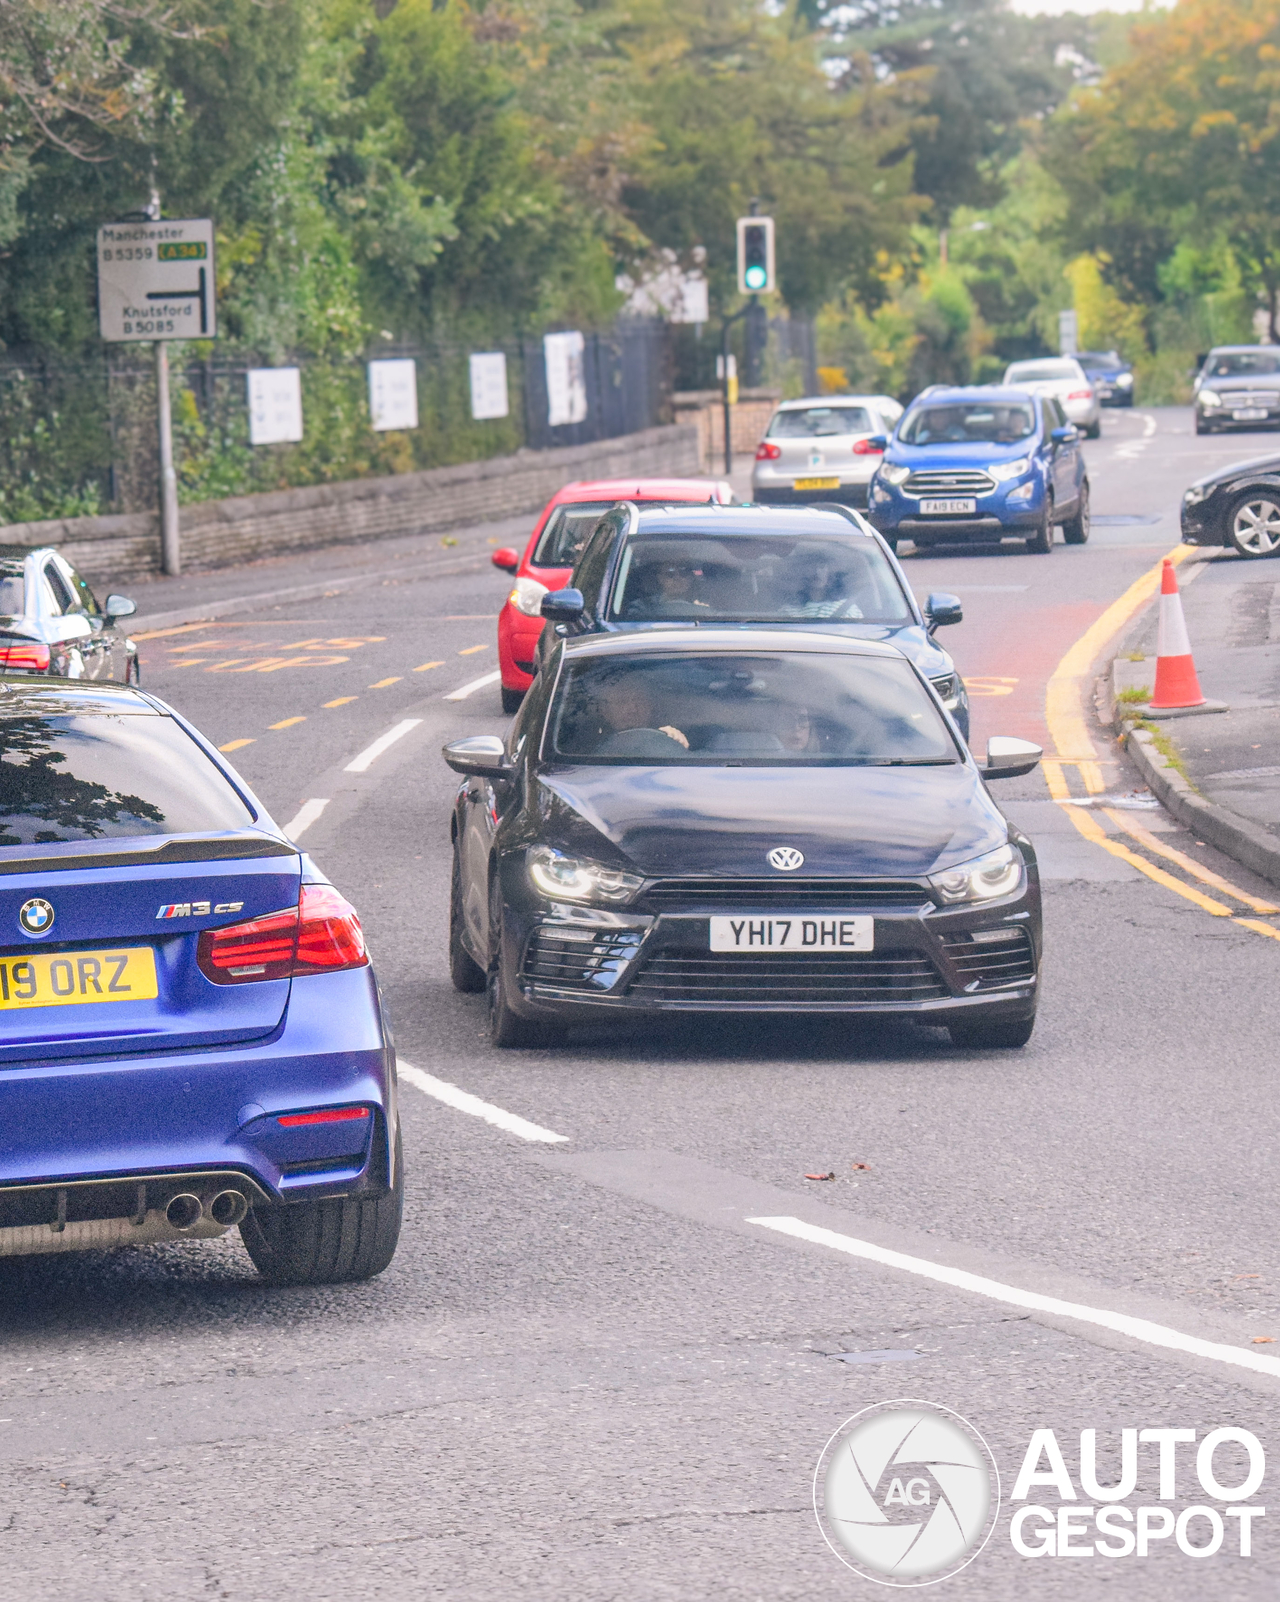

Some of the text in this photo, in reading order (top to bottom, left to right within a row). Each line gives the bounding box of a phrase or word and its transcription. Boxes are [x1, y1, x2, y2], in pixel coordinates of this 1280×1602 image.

[102, 228, 184, 241] Manchester
[122, 303, 192, 318] Knutsford
[926, 500, 969, 512] FA19 ECN
[214, 902, 244, 914] CS
[730, 921, 855, 945] YH17 DHE
[50, 955, 132, 997] ORZ
